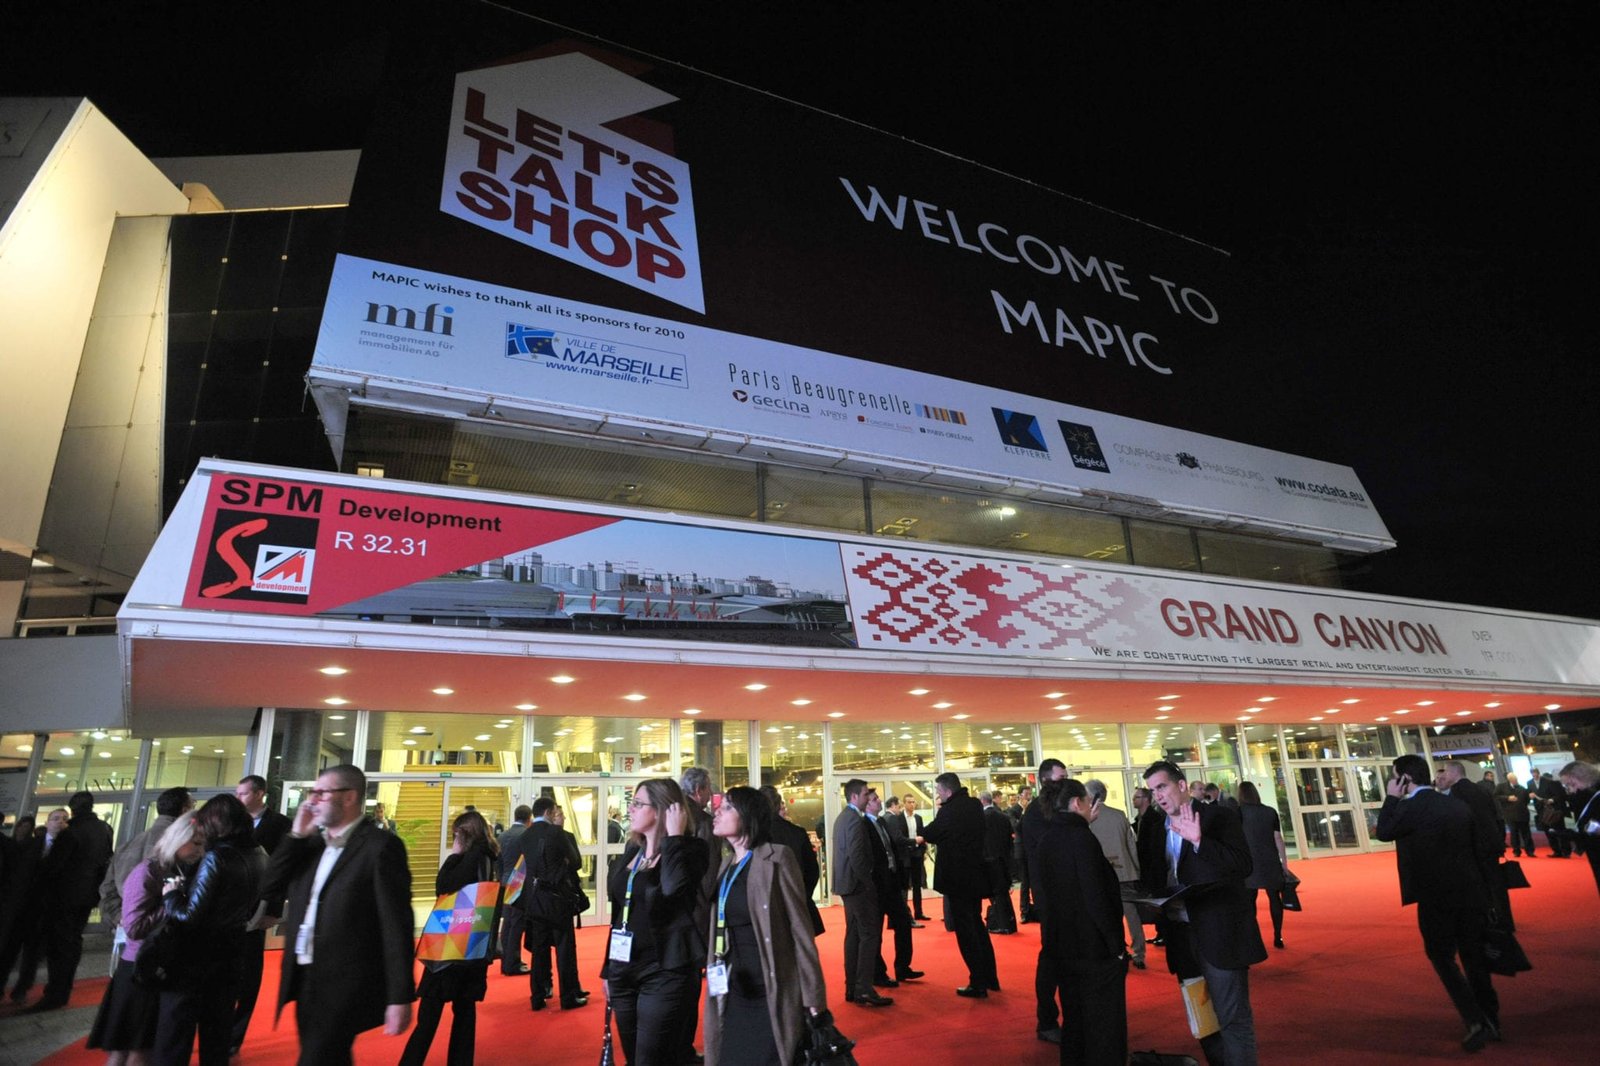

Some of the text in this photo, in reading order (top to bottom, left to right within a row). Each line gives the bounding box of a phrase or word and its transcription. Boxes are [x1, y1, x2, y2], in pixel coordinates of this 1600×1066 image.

[463, 87, 680, 206] LET'S
[463, 124, 682, 251] TALK
[455, 170, 686, 284] SHOP
[839, 177, 1220, 325] WELCOME TO
[363, 301, 455, 337] mfi
[372, 271, 685, 340] MAPIC wishes to thank all its sponsors for 2010
[358, 337, 440, 358] immobilien AG
[360, 329, 455, 350] management für
[567, 337, 617, 354] VILLE DE
[990, 290, 1173, 376] MAPIC
[545, 361, 653, 385] www.marseille.fr
[563, 347, 683, 382] MARSEILLE
[728, 362, 912, 416] Paris Beaugrenelle
[220, 478, 323, 514] SPM
[1274, 476, 1365, 502] www.codata.eu
[339, 499, 502, 532] Development
[334, 531, 427, 557] R 32.31
[255, 582, 307, 593] development
[1160, 597, 1448, 655] GRAND CANYON
[1091, 646, 1112, 657] WE
[1116, 650, 1140, 659] ARE
[1144, 651, 1229, 664] CONSTRUCTING
[1232, 655, 1253, 665] THE
[1256, 657, 1298, 667] LARGEST
[1302, 660, 1333, 669] RETAIL
[1335, 662, 1354, 670] AND
[1356, 662, 1421, 674] ENTERTAINMENT
[1423, 666, 1453, 676] CENTER
